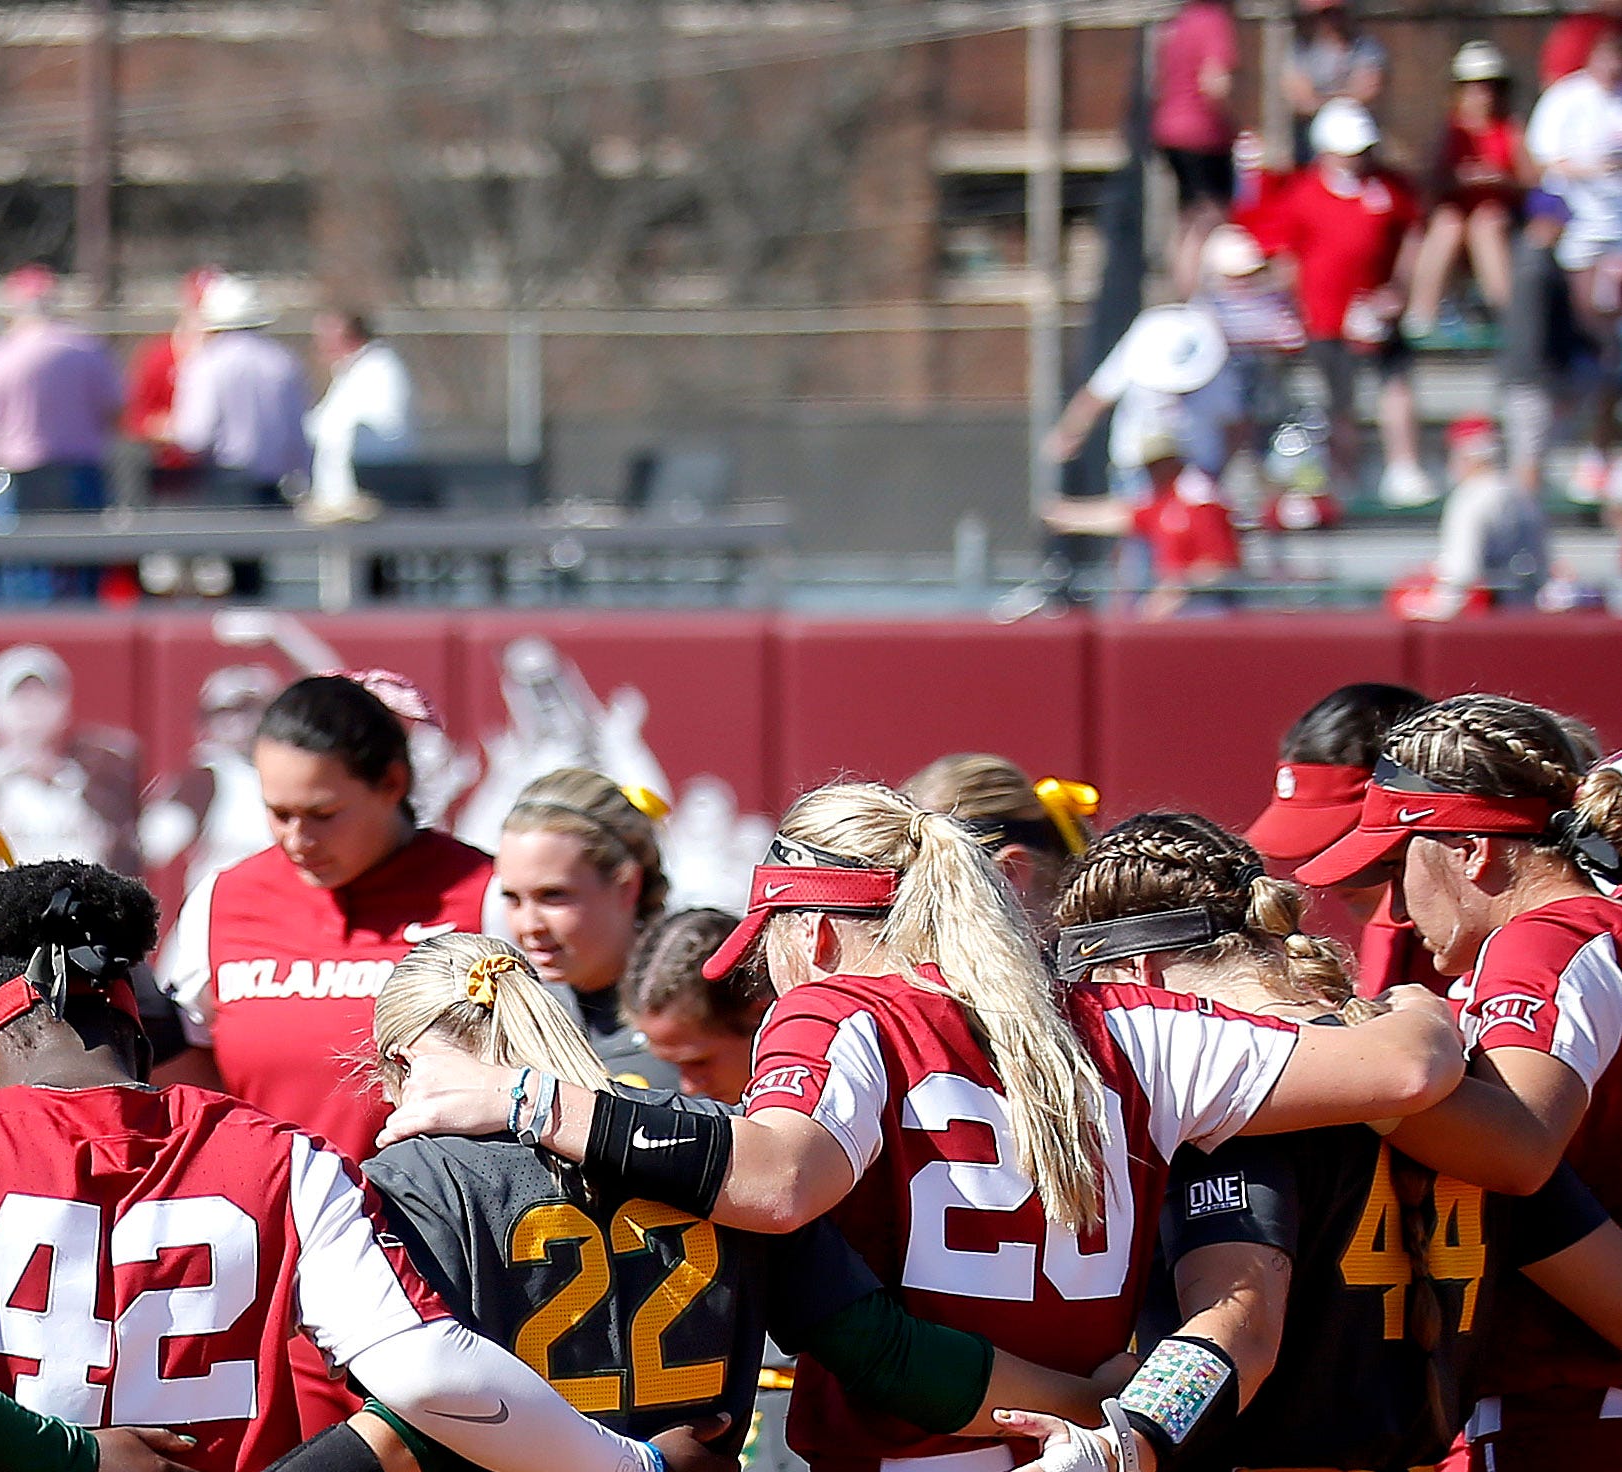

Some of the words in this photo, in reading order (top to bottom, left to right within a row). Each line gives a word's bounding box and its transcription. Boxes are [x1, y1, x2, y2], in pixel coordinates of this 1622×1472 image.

[901, 1072, 1135, 1302] 20
[1190, 1176, 1240, 1208] ONE
[1339, 1141, 1486, 1340] 44
[506, 1198, 727, 1411] 22
